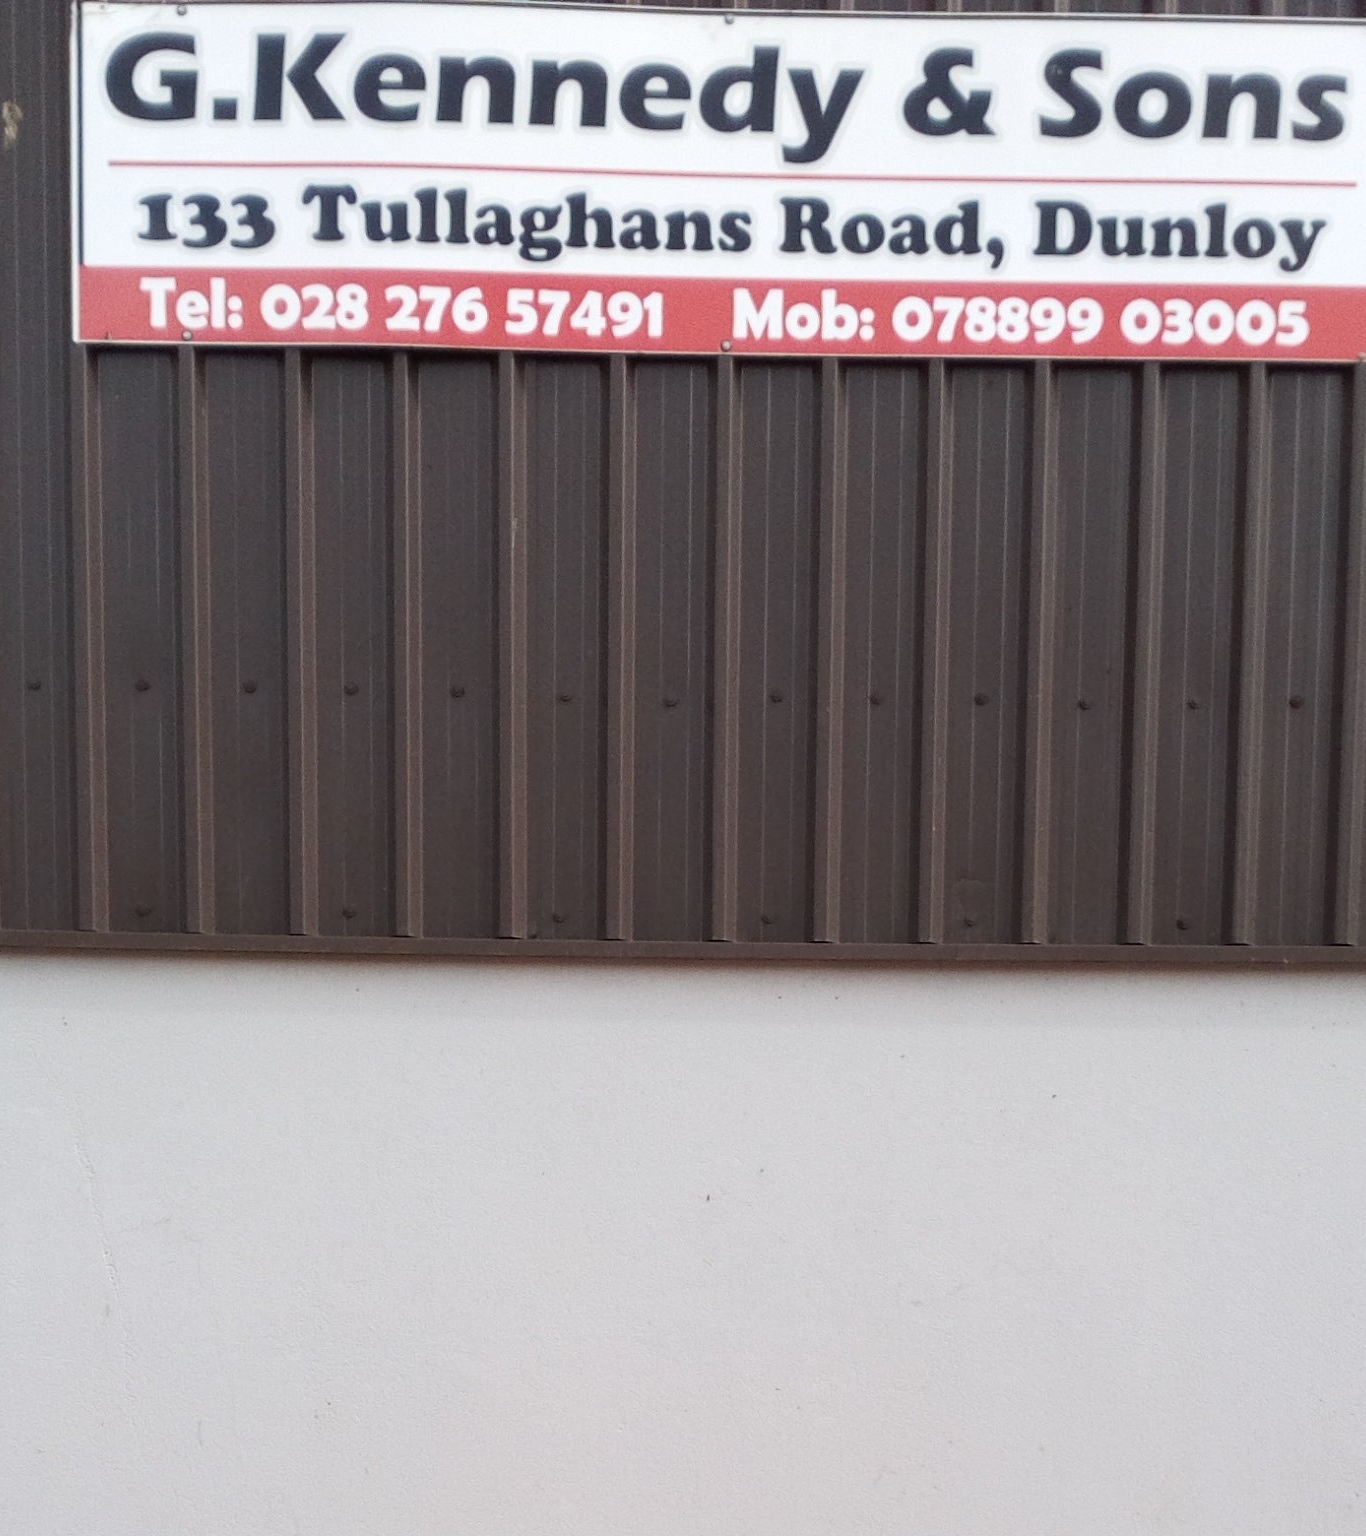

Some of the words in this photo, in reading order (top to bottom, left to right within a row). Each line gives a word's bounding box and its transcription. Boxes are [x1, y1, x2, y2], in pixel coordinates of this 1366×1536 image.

[104, 32, 863, 164] G.Kennedy
[903, 50, 992, 137] &
[1040, 48, 1346, 141] Sons
[137, 194, 276, 249] 133
[303, 187, 751, 262] Tullaghans
[780, 199, 1004, 269] Road,
[1034, 202, 1325, 273] Dunloy
[138, 276, 244, 332] Tel:
[259, 282, 370, 333] 028
[384, 284, 490, 335] 276
[504, 287, 664, 339] 57491
[732, 287, 876, 343] Mob:
[891, 295, 1105, 345] 078899
[1119, 297, 1311, 348] 03005
